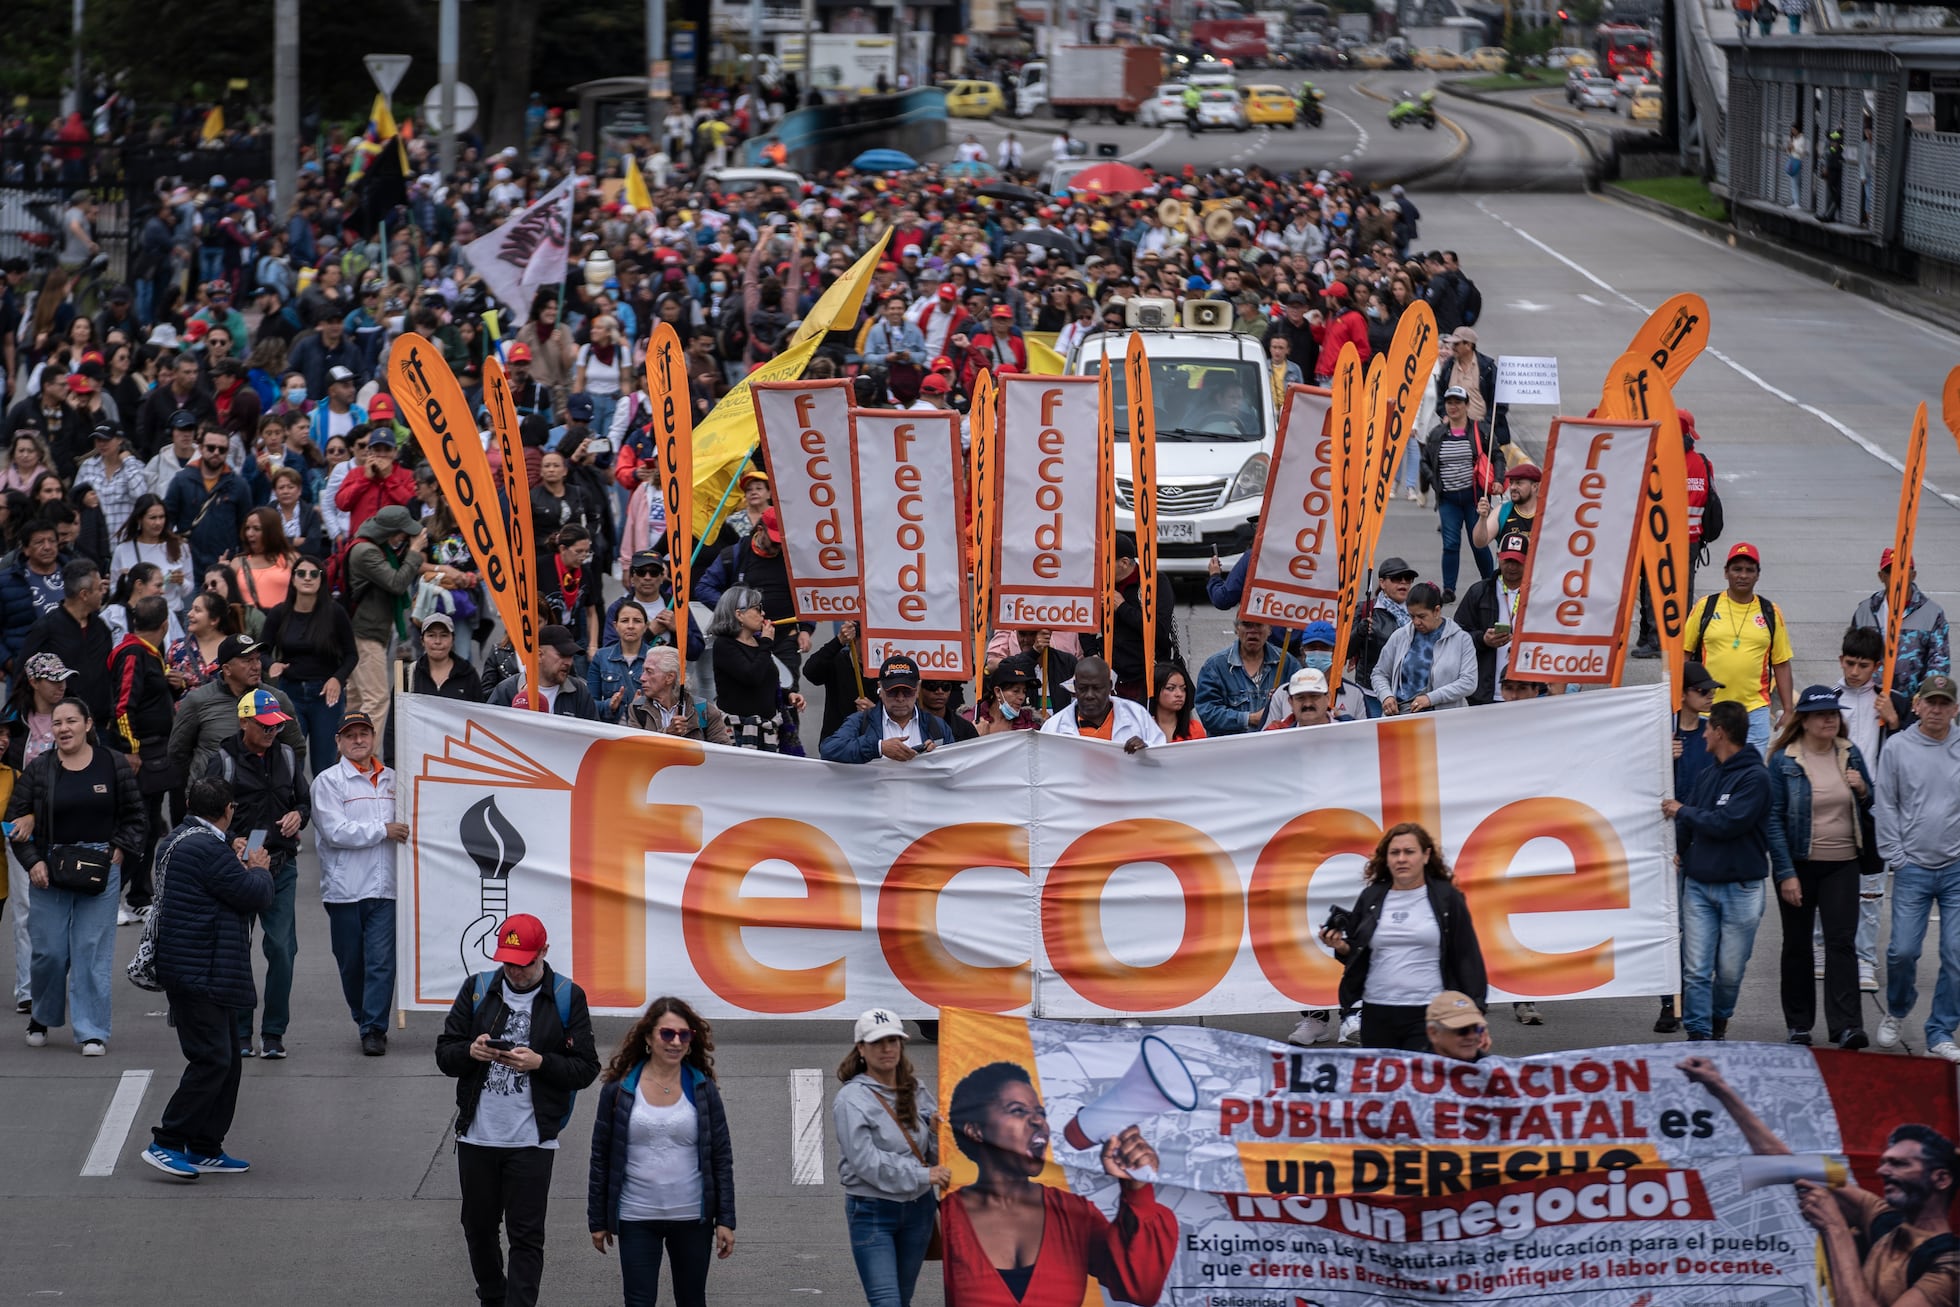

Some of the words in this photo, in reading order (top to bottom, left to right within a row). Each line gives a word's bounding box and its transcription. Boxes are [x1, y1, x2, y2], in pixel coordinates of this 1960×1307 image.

[410, 347, 506, 593] fecode
[496, 378, 533, 653] fecode
[663, 341, 684, 609] fecode
[794, 393, 847, 571] fecode
[894, 424, 928, 622] fecode
[1033, 388, 1065, 579] fecode
[1137, 350, 1152, 623] fecode
[1556, 432, 1614, 627] fecode
[1014, 597, 1089, 623] fecode
[1262, 595, 1336, 622] fecode
[1530, 645, 1605, 673] fecode
[571, 717, 1631, 1015] fecode
[1220, 1090, 1422, 1139] PÚBLICA
[1433, 1099, 1648, 1140] ESTATAL
[1659, 1109, 1715, 1138] es
[1350, 1057, 1650, 1098] EDUCACIÓN
[1265, 1158, 1336, 1195] un
[1339, 1197, 1406, 1243] un
[1421, 1169, 1691, 1241] negocio!
[1187, 1233, 1286, 1256] Exigimos
[1292, 1241, 1328, 1255] una
[1334, 1242, 1364, 1263] Ley
[1370, 1247, 1476, 1269] Estatutaria
[1483, 1246, 1508, 1263] de
[1514, 1235, 1622, 1260] Educación
[1630, 1237, 1678, 1255] para
[1686, 1232, 1704, 1248] el
[1712, 1234, 1797, 1255] pueblo,
[1202, 1262, 1242, 1281] que
[1249, 1258, 1314, 1278] cierre
[1320, 1260, 1350, 1281] las
[1355, 1266, 1430, 1292] Brechas
[1436, 1278, 1449, 1295] y
[1457, 1266, 1575, 1294] Dignifique
[1581, 1261, 1600, 1280] la
[1607, 1258, 1669, 1277] labor
[1675, 1257, 1783, 1275] Docente.
